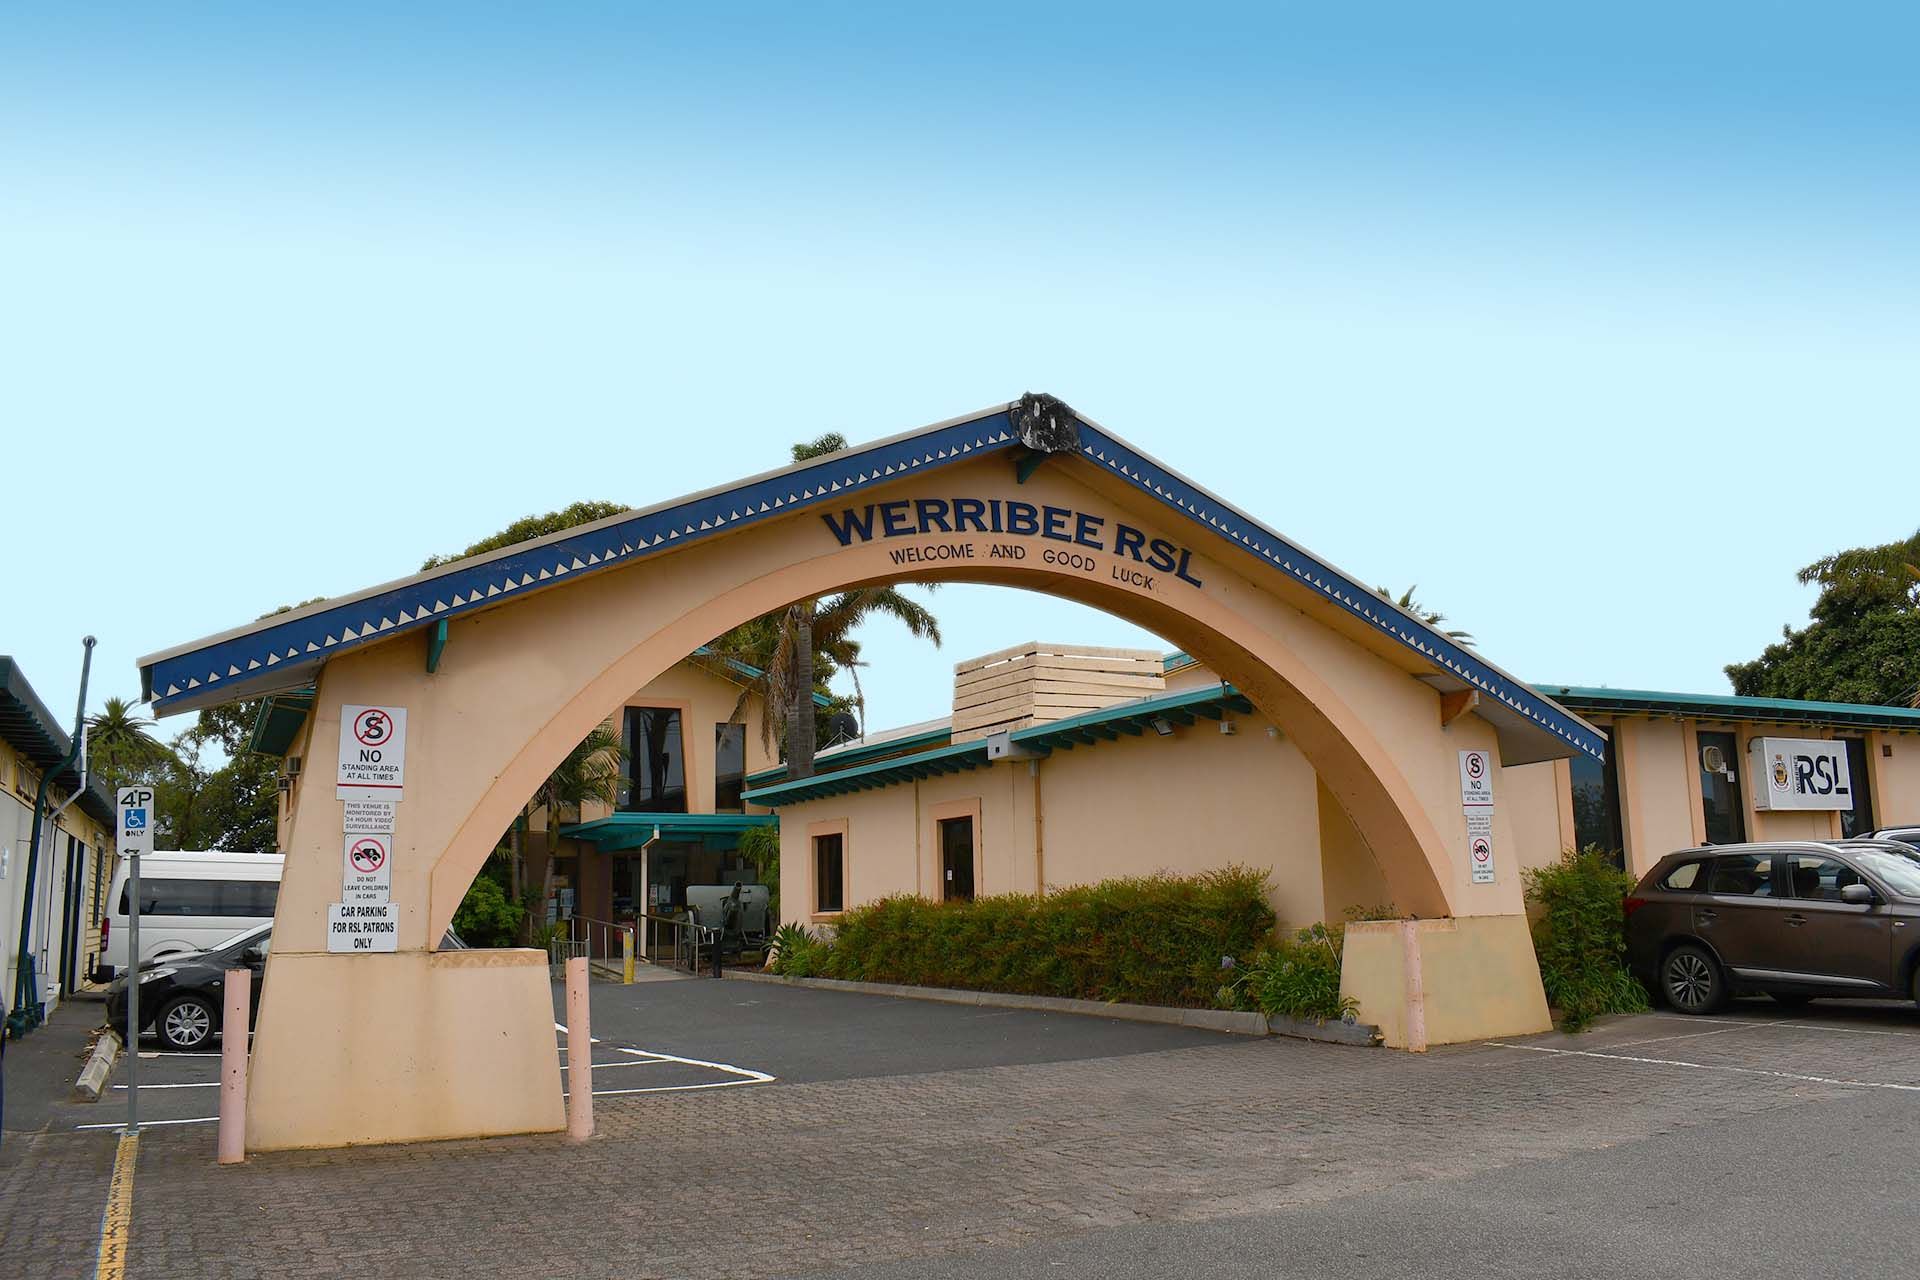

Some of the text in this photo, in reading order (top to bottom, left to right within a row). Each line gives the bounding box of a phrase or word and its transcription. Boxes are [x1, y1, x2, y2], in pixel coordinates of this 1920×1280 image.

[821, 498, 1202, 588] WERRIBEE RSL
[890, 544, 1154, 590] WELCOME AND GOOD LUCK
[360, 749, 382, 763] NO
[342, 763, 399, 773] STANDING AREA
[373, 773, 394, 781] TIMES
[1797, 755, 1849, 795] RSL
[1470, 780, 1482, 790] NO
[120, 791, 152, 808] 4P
[341, 906, 387, 917] CAR PARKING
[332, 922, 395, 933] FOR RSL PATRONS
[354, 937, 372, 949] ONLY
